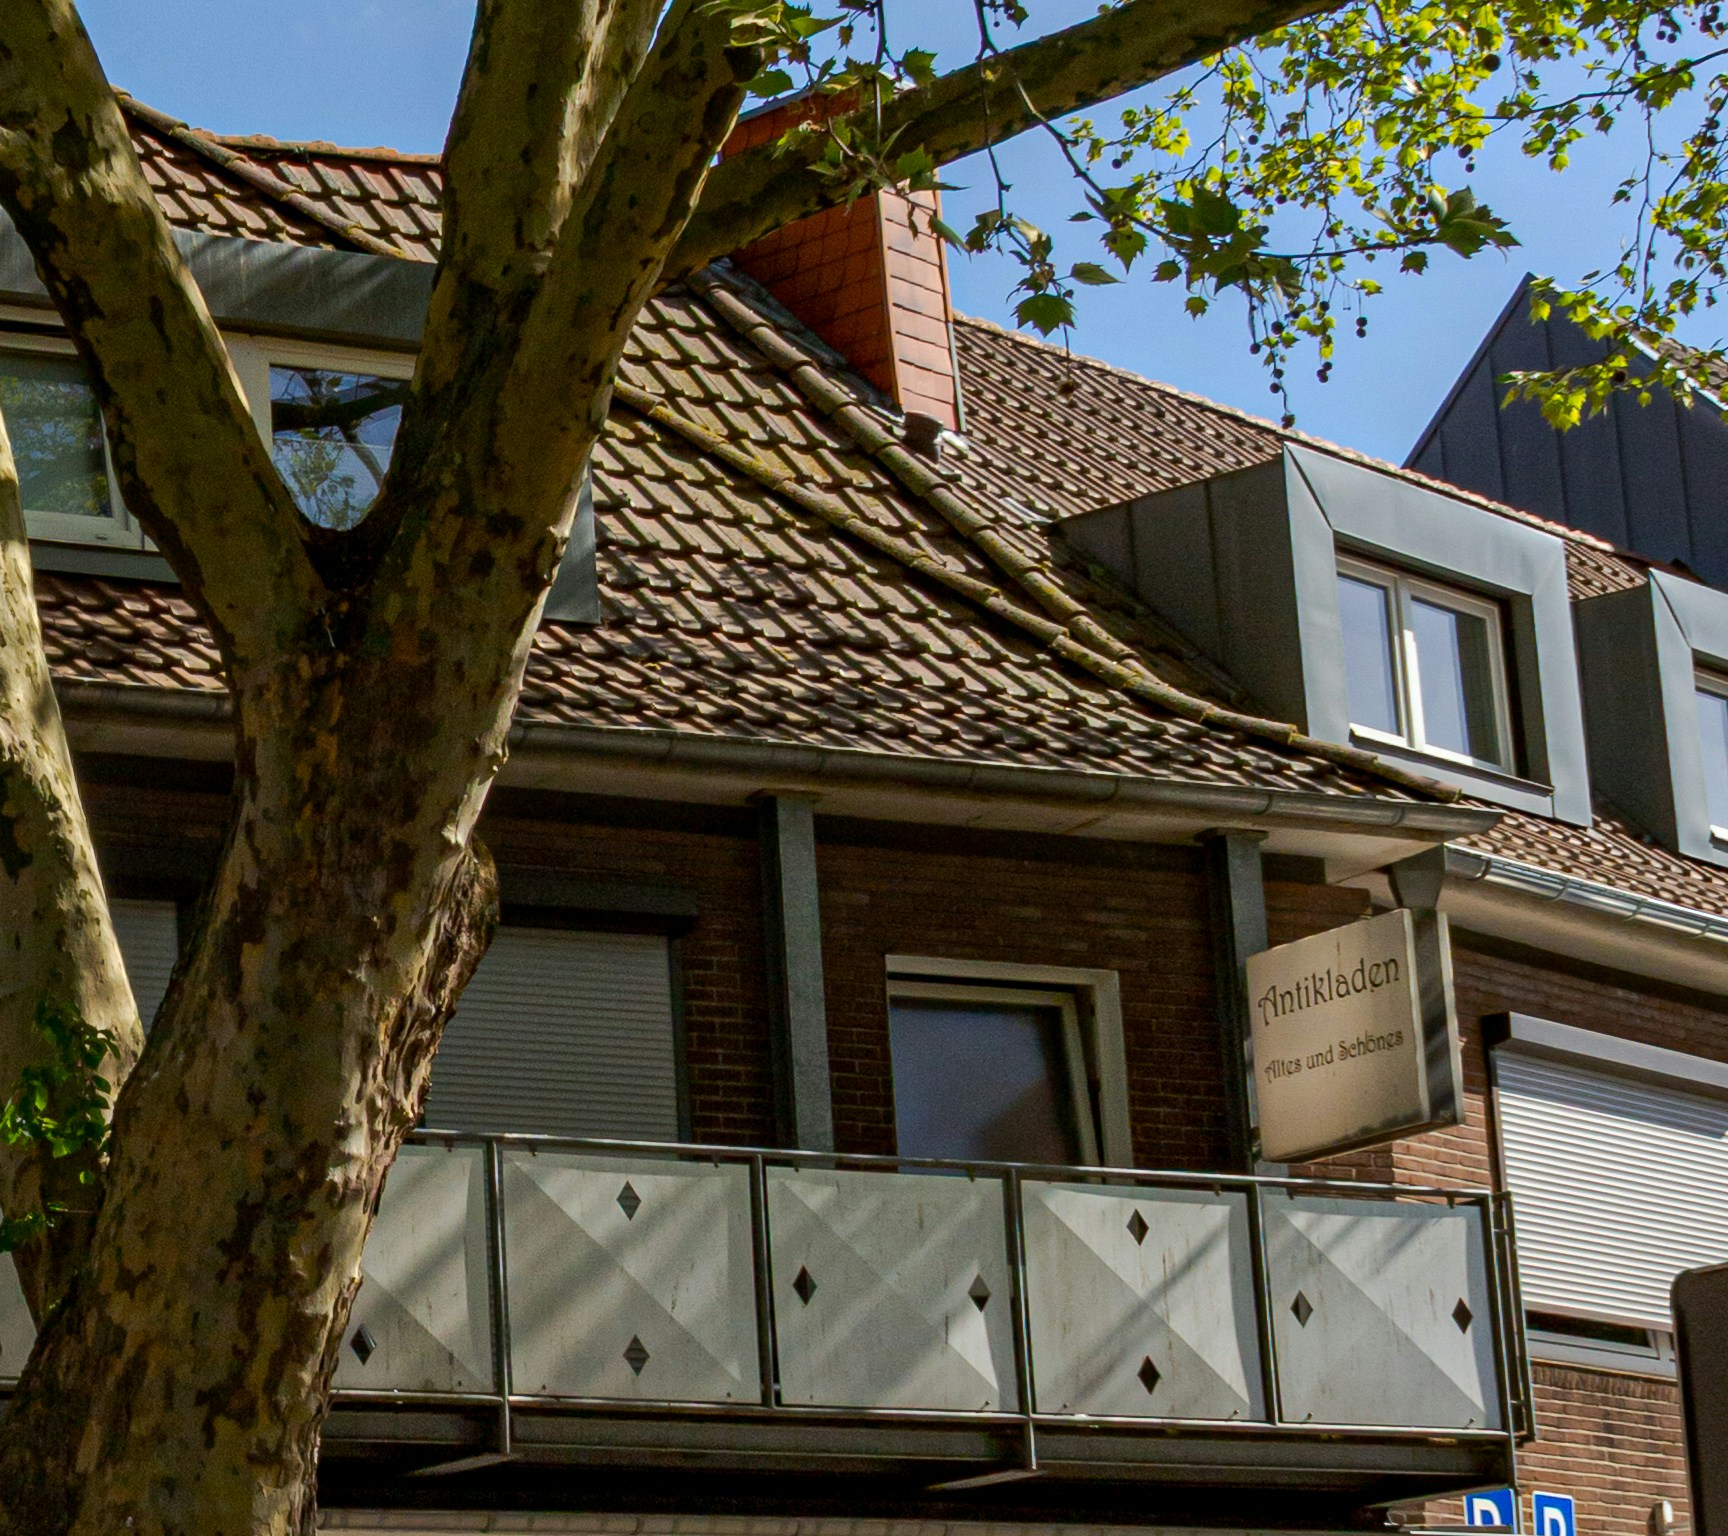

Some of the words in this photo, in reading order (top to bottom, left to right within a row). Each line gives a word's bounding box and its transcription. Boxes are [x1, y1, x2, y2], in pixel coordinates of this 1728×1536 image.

[1258, 957, 1400, 1026] Antikladen
[1264, 1059, 1302, 1084] Altes
[1306, 1045, 1334, 1070] und
[1337, 1030, 1404, 1061] Schönes
